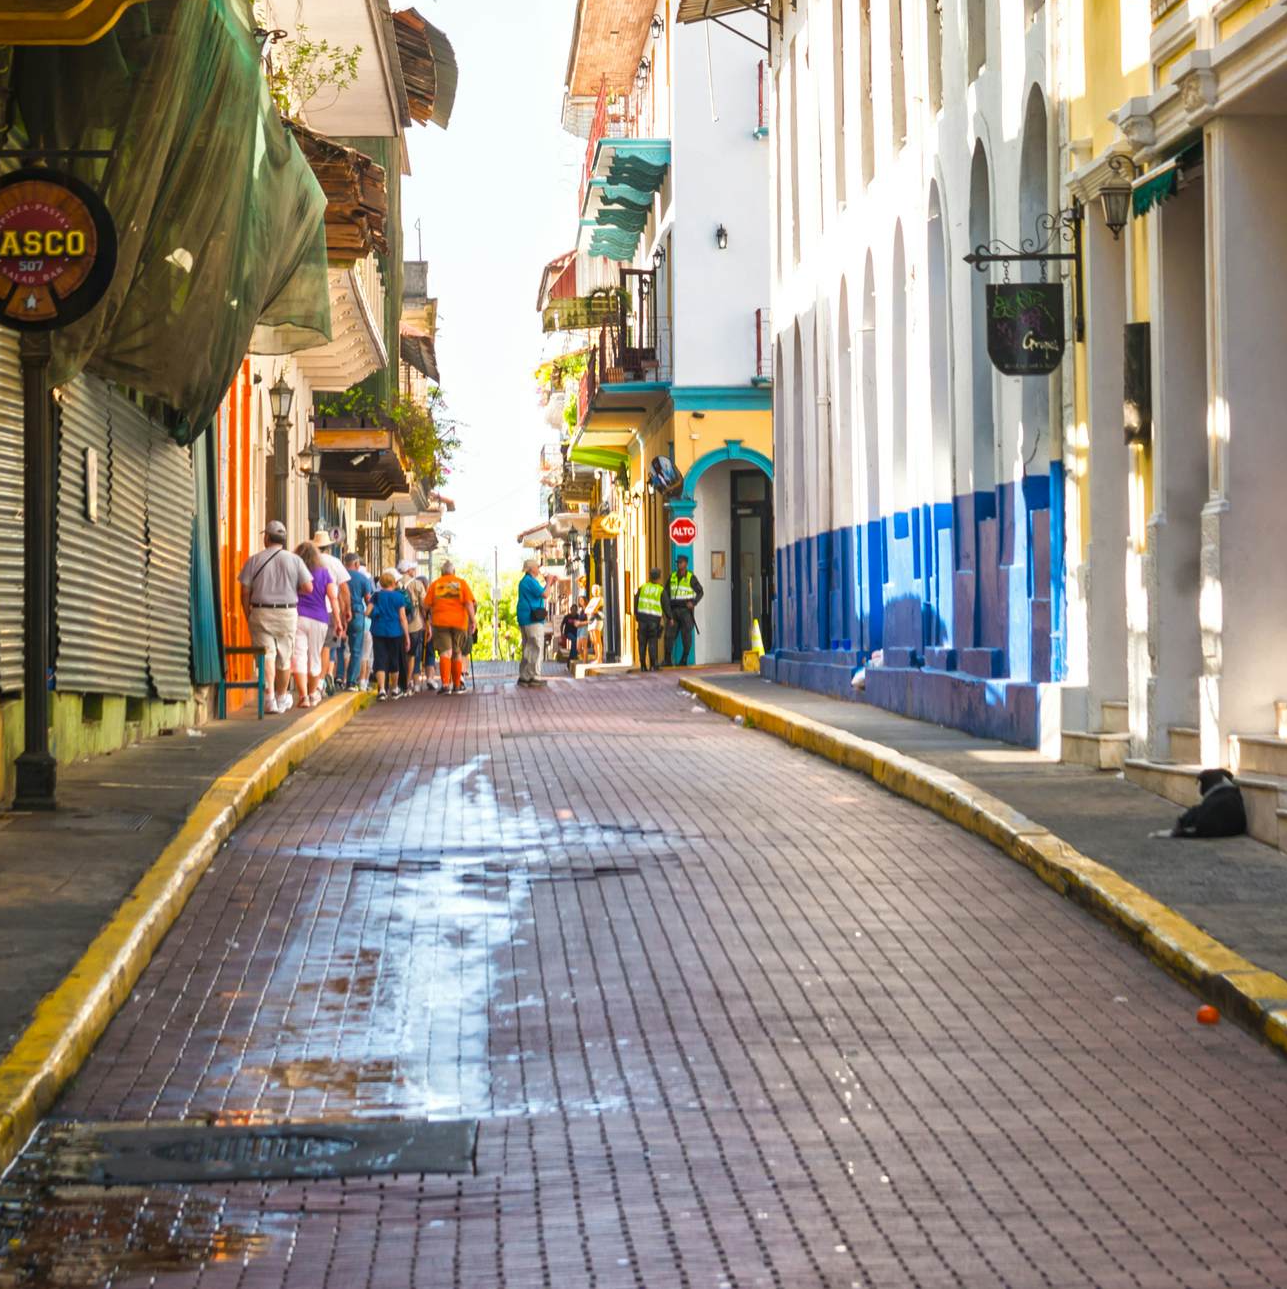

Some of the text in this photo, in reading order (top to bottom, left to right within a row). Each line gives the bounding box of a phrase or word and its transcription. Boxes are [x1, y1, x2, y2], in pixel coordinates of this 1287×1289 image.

[19, 260, 44, 272] 507
[42, 266, 65, 281] BAR
[672, 527, 695, 536] ALTO
